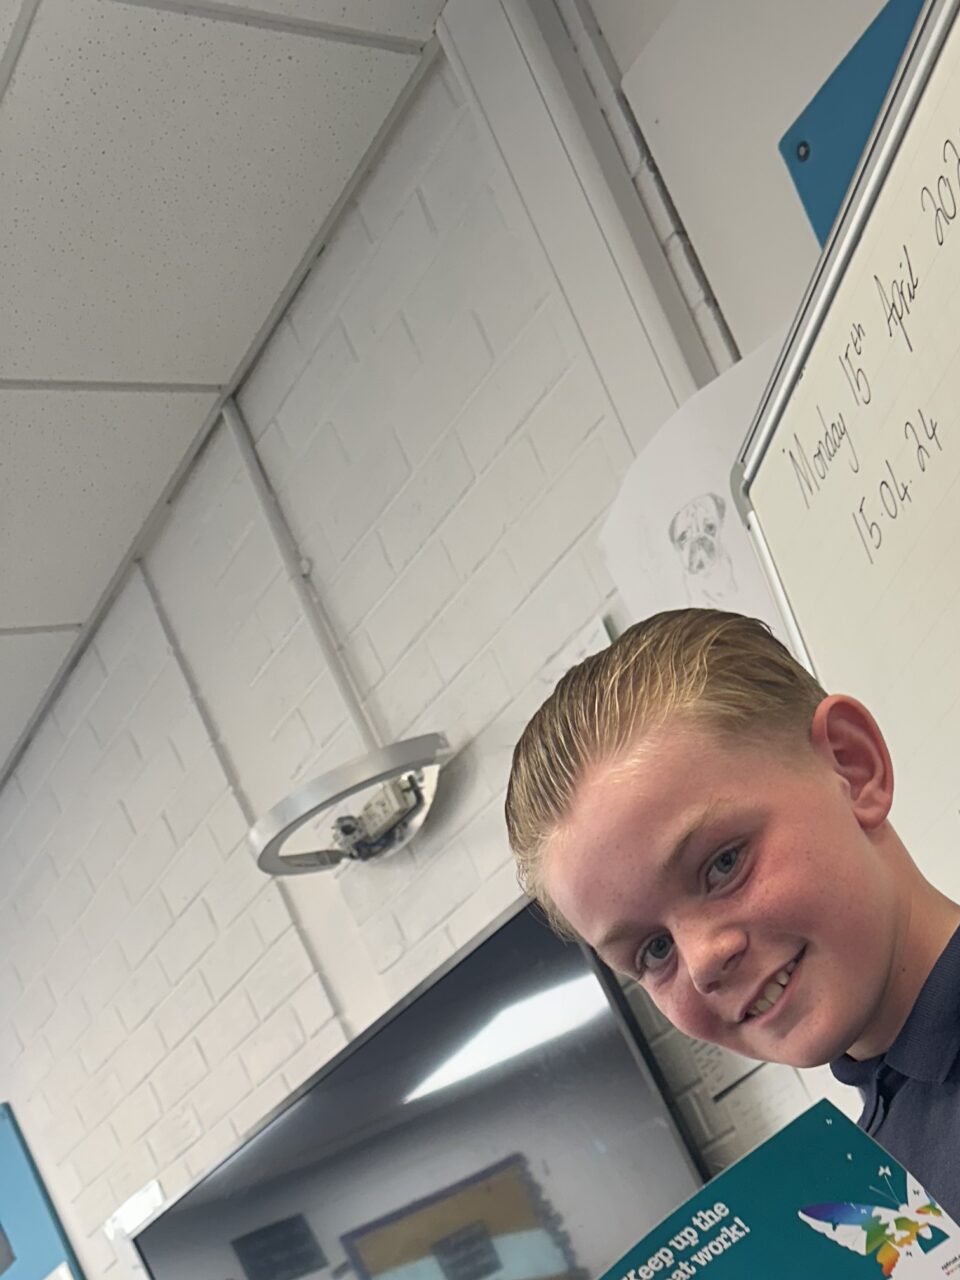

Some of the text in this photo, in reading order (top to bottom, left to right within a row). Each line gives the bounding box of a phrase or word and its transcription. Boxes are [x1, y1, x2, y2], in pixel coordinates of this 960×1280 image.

[782, 405, 860, 510] Monday
[874, 245, 919, 352] April
[669, 1226, 700, 1251] up
[692, 1201, 730, 1232] the
[691, 1216, 751, 1267] work!
